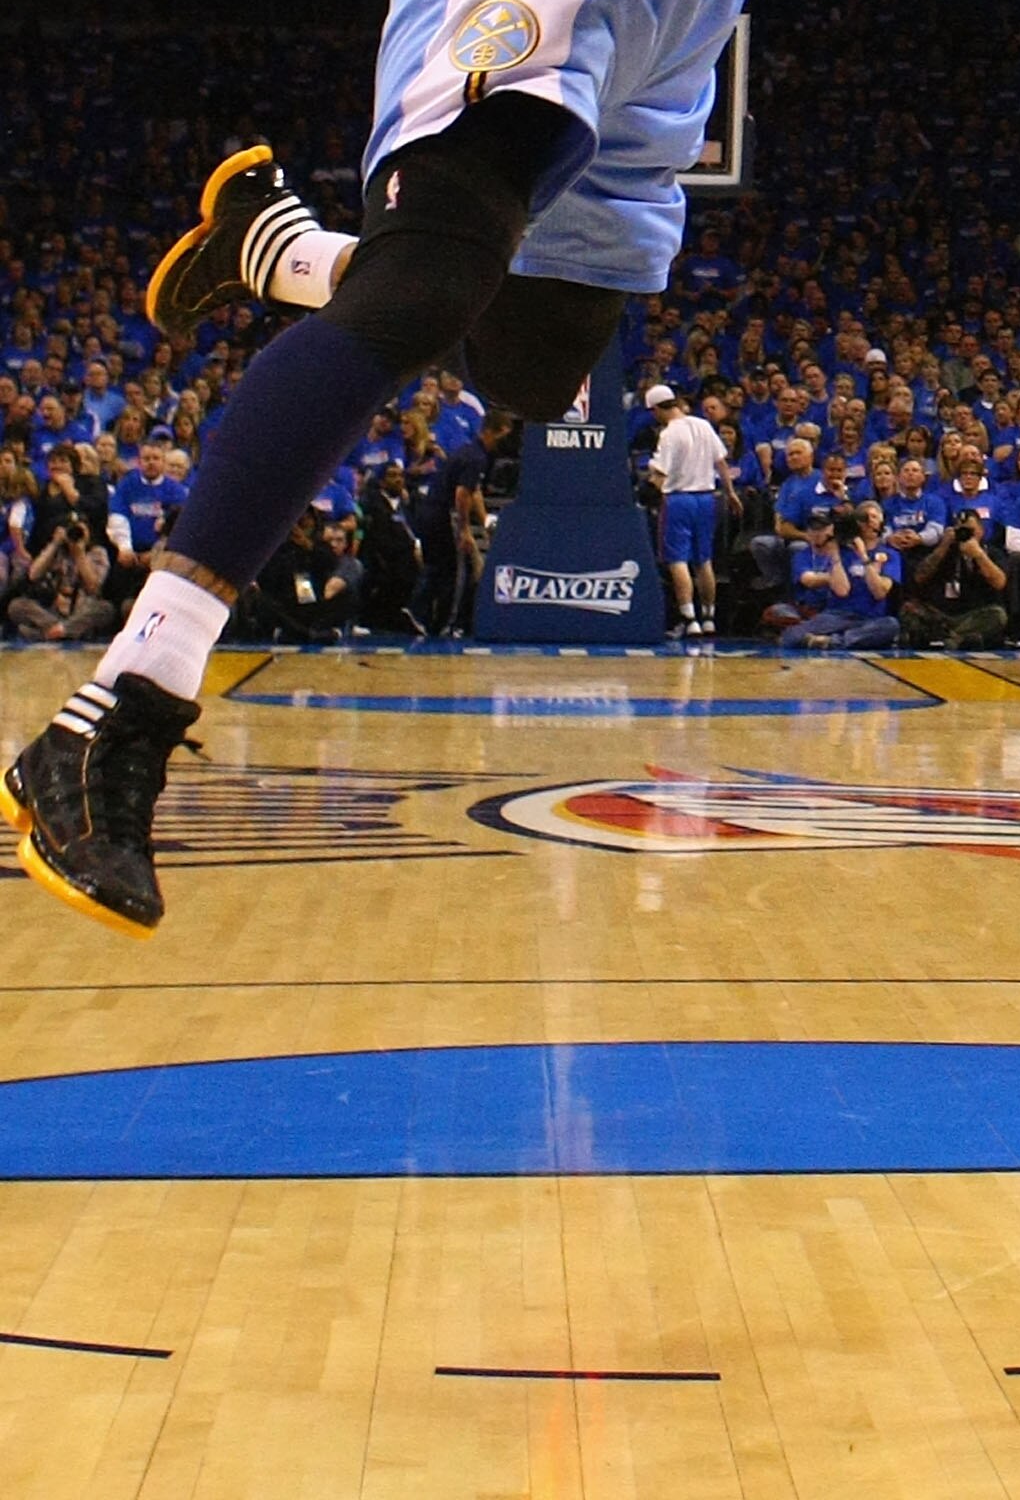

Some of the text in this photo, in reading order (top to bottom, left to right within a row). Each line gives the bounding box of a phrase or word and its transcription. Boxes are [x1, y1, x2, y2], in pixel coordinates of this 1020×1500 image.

[546, 429, 606, 449] NBA TV
[512, 574, 635, 601] PLAYOFFS
